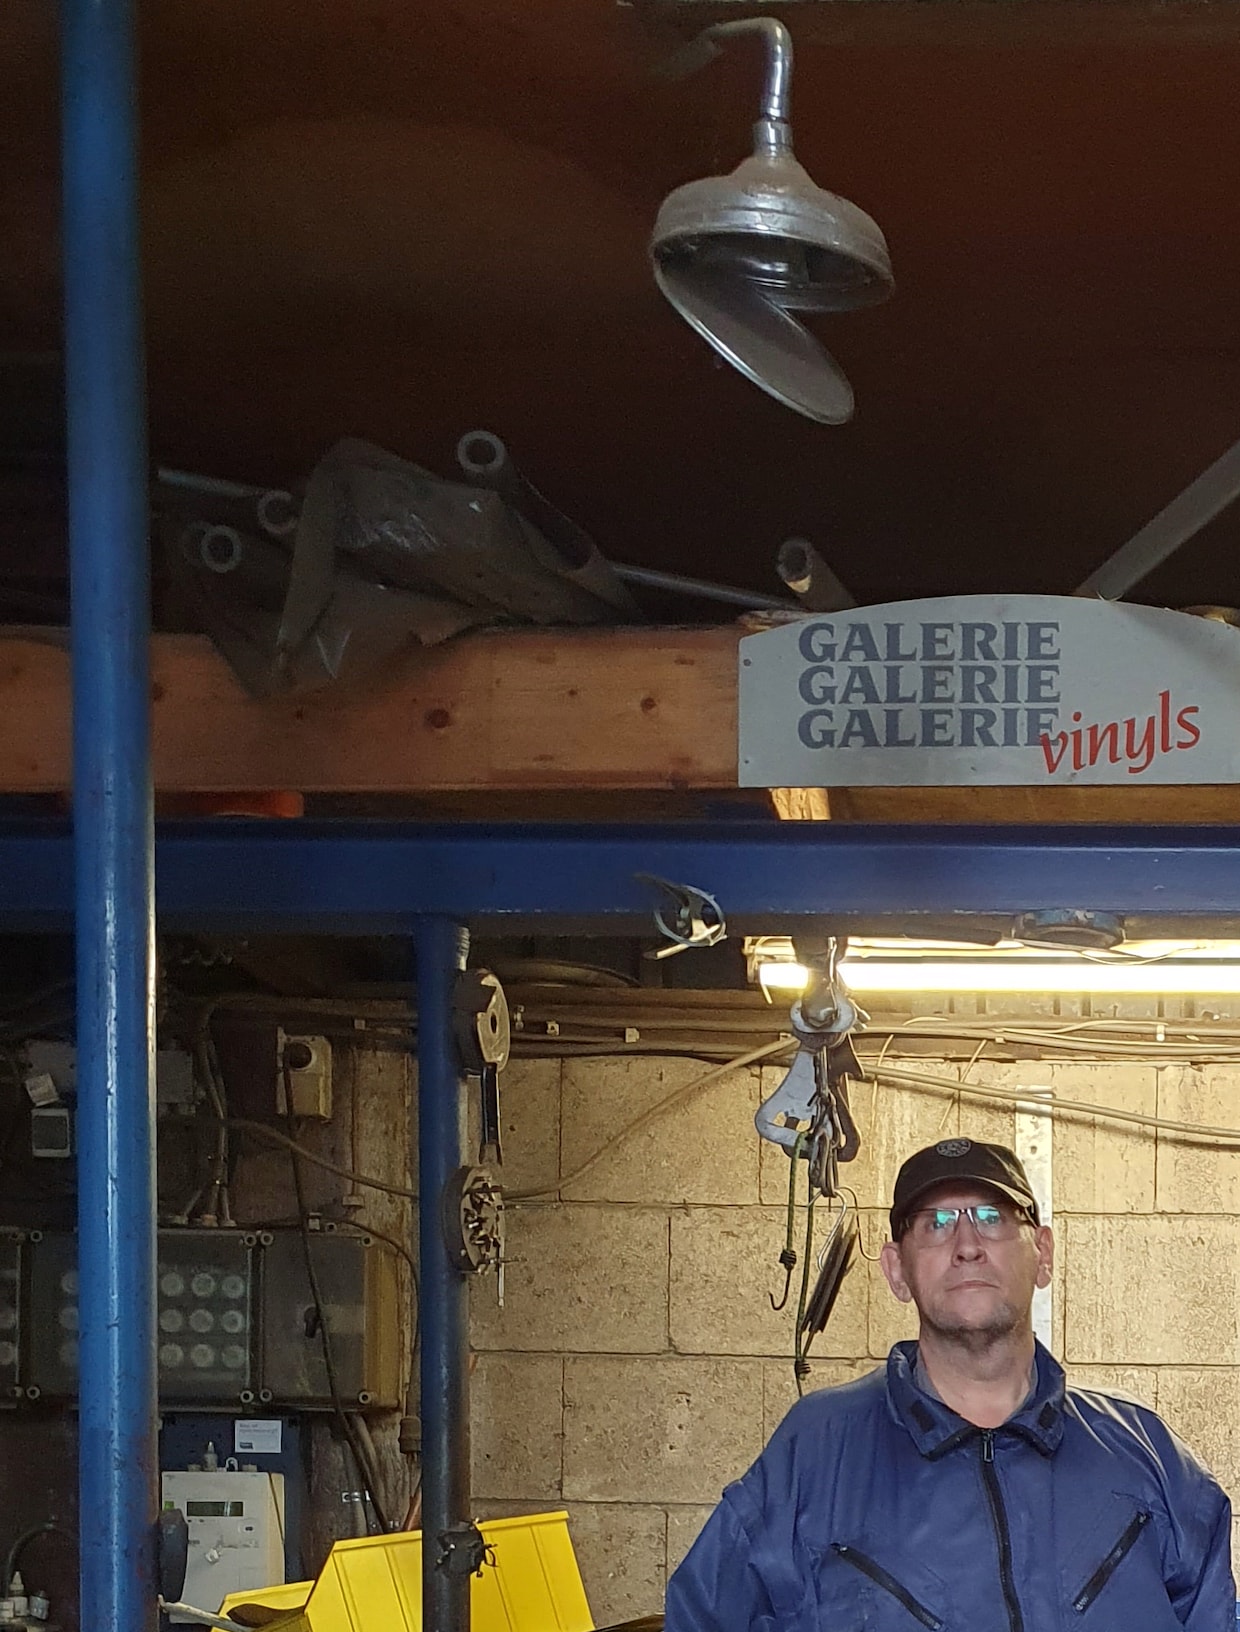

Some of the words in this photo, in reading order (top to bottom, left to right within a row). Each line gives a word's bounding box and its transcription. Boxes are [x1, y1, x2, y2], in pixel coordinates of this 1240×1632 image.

[799, 621, 1061, 662] GALERIE
[799, 664, 1061, 704] GALERIE
[798, 707, 1061, 749] GALERIE
[1039, 691, 1200, 774] vinyls
